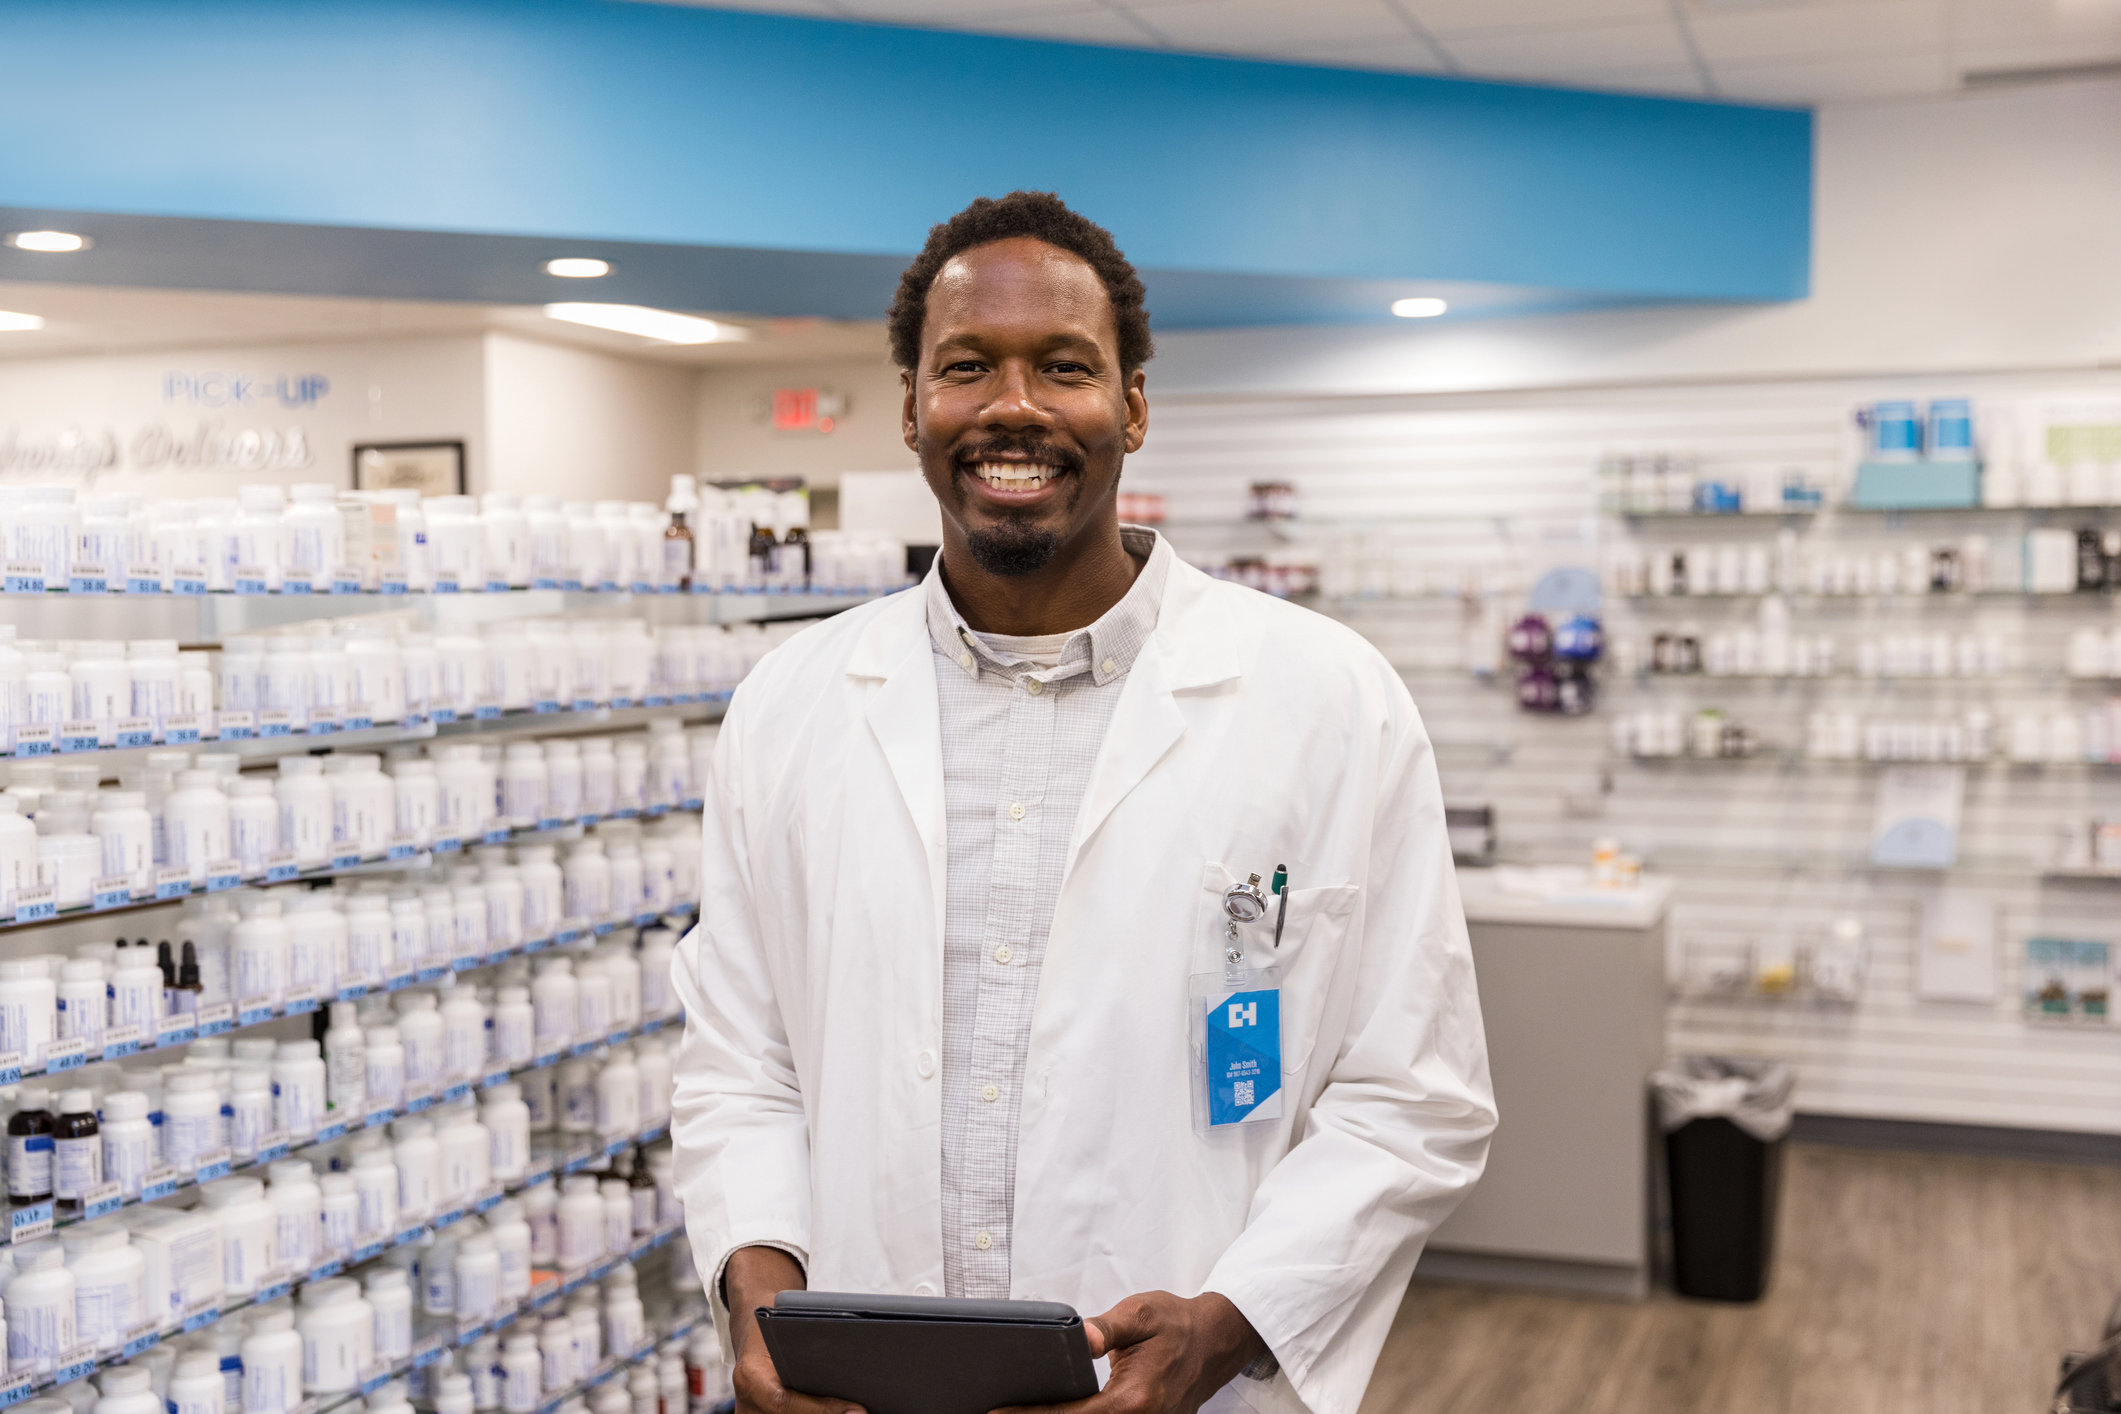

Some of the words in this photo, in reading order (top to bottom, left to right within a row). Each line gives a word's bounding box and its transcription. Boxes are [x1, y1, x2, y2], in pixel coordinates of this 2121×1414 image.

[163, 369, 330, 409] PICK-UP
[1230, 1061, 1242, 1070] John
[1242, 1059, 1258, 1069] Smith
